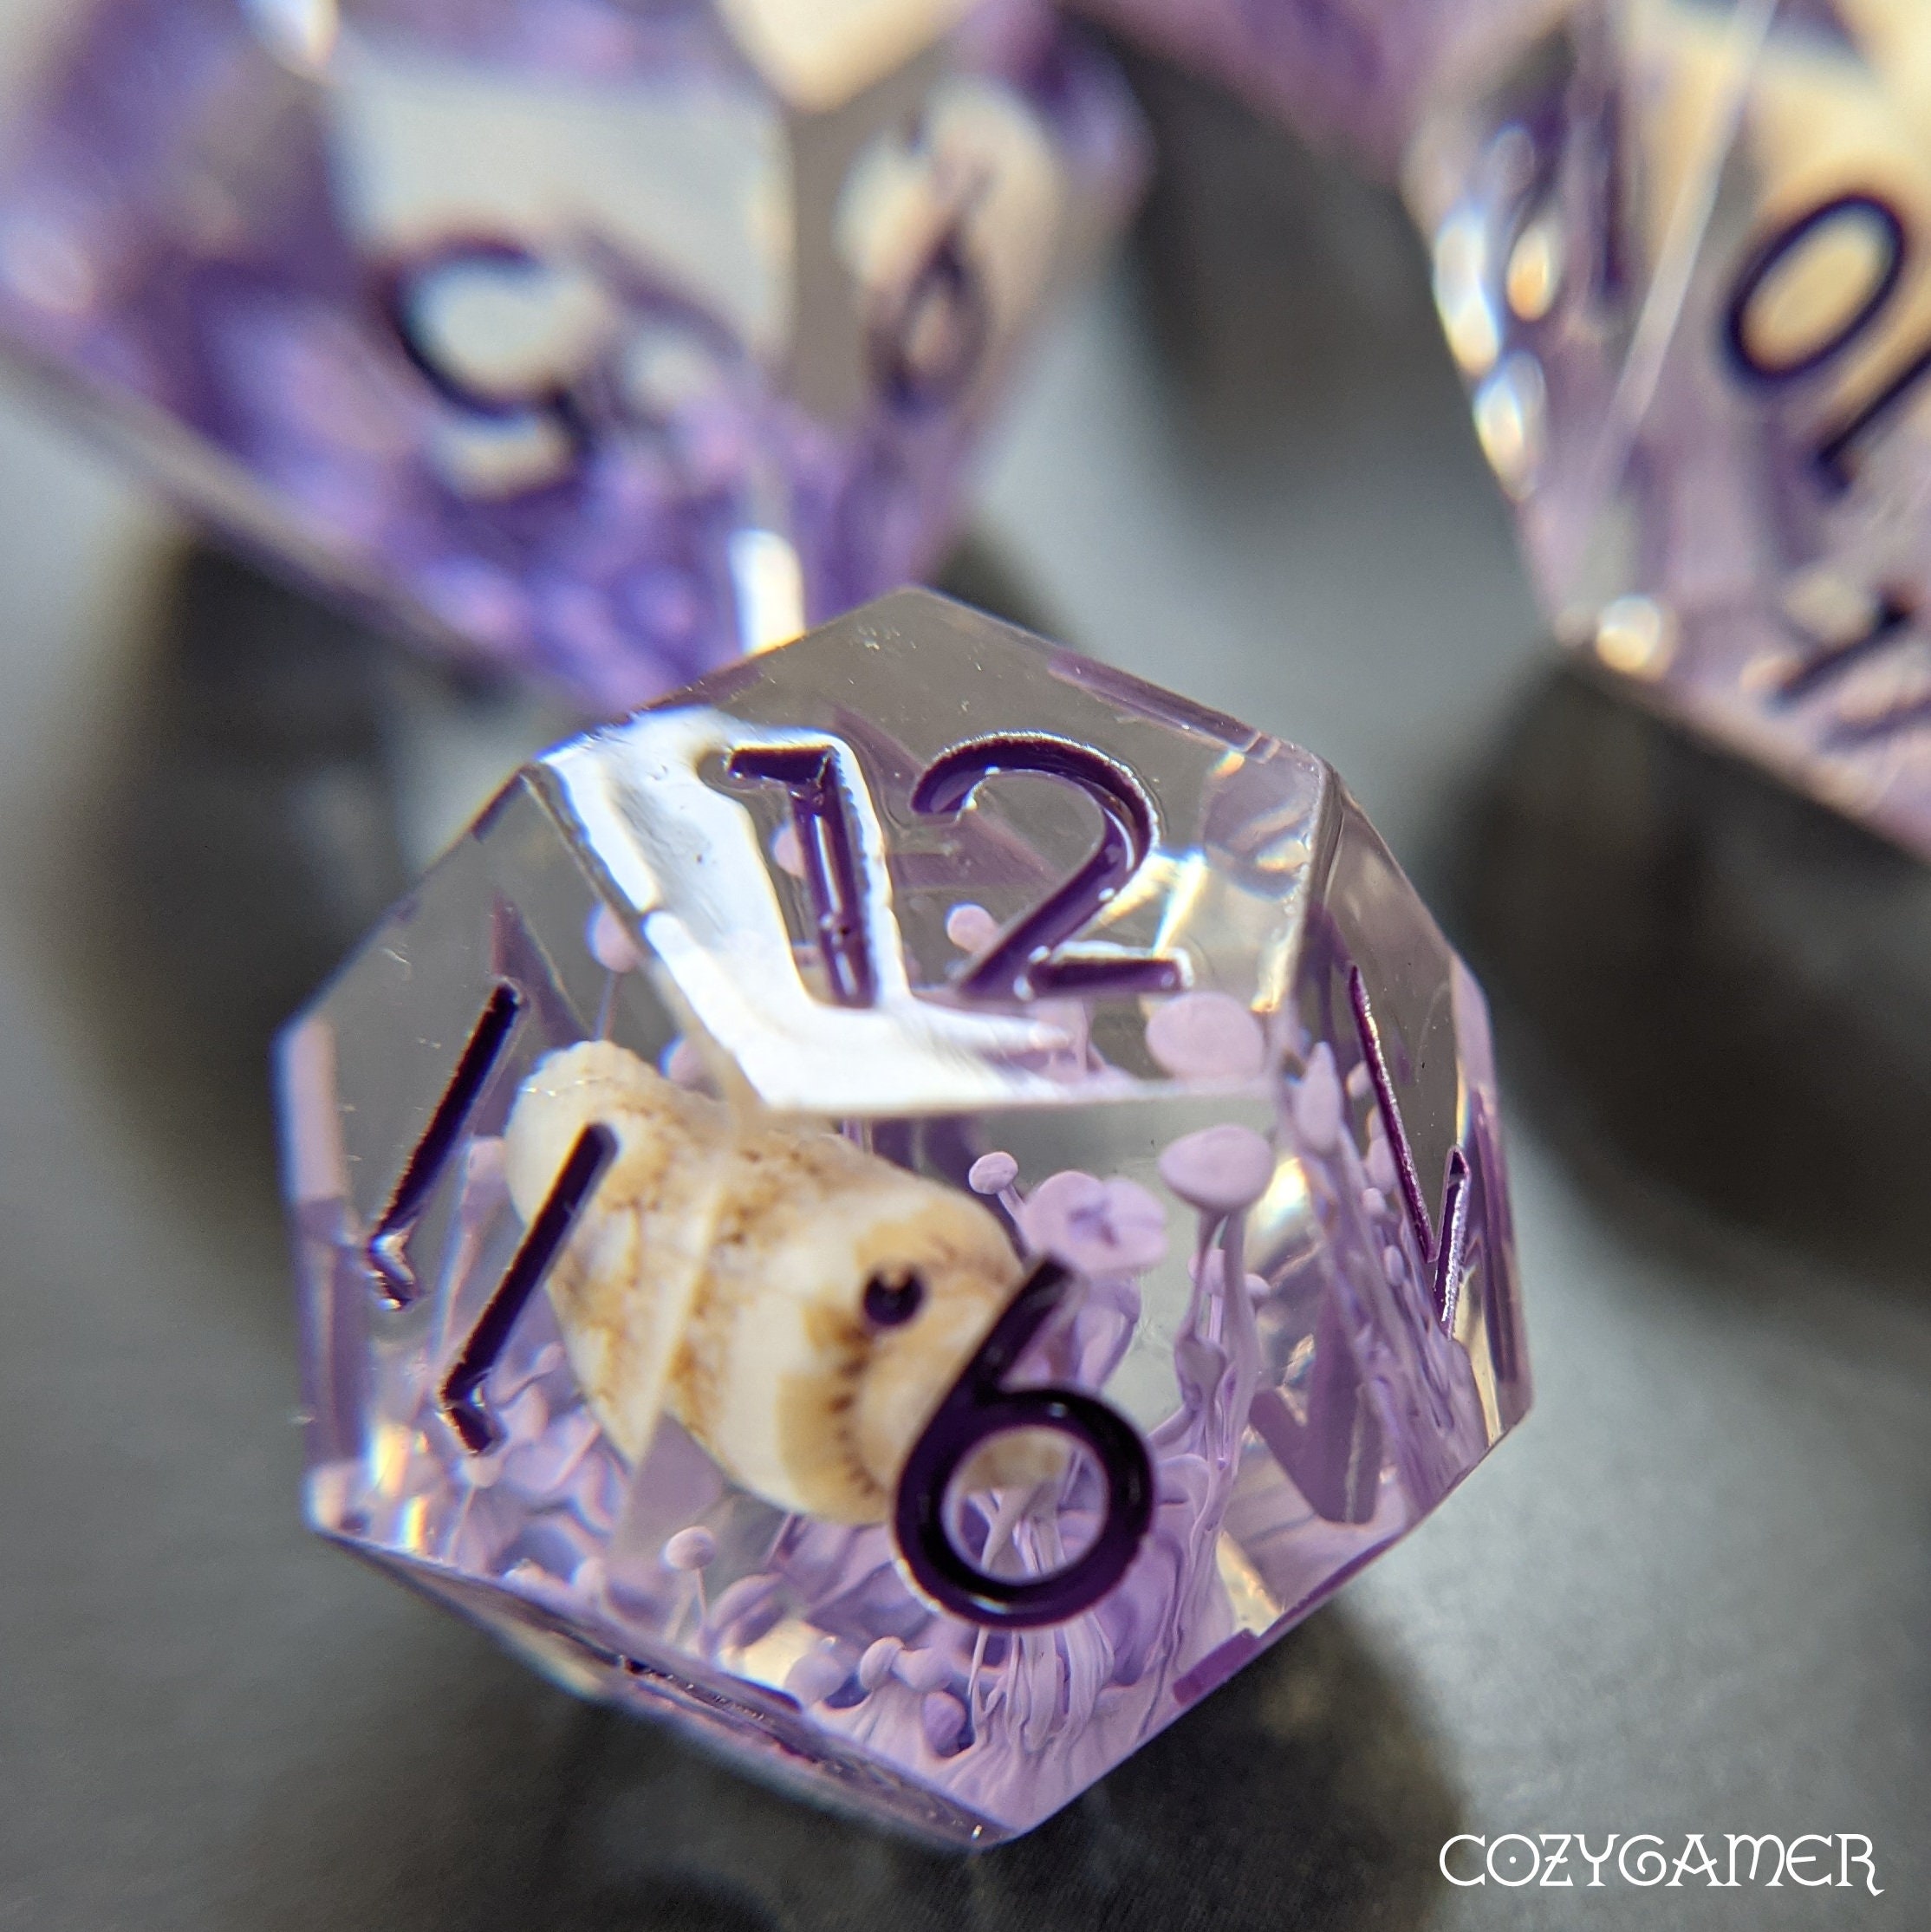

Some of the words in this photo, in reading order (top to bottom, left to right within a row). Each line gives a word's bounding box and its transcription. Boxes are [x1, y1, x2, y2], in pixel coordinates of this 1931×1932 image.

[725, 730, 1194, 1009] 12
[365, 979, 620, 1456] 11
[892, 1253, 1156, 1630] 6
